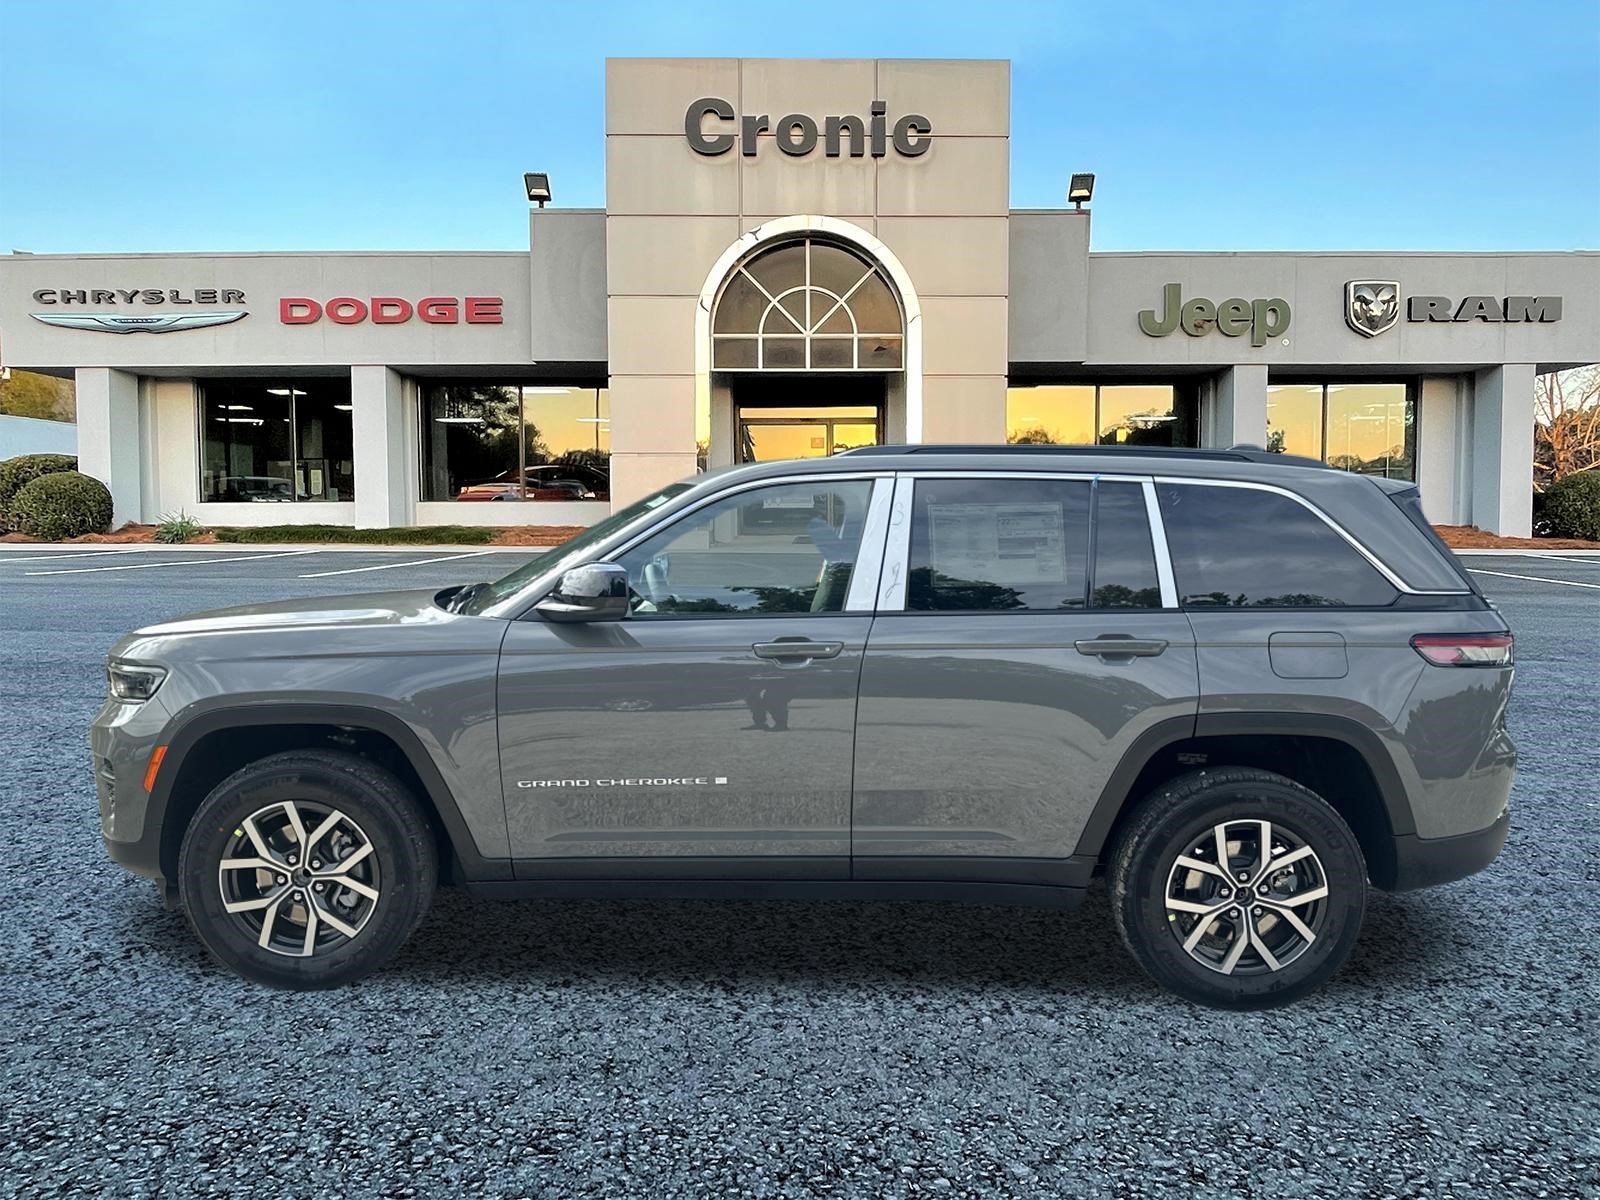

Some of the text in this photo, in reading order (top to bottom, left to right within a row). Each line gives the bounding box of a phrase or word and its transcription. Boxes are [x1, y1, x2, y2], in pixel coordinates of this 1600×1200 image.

[685, 98, 932, 157] Cronic
[32, 289, 246, 304] CHRYSLER
[1407, 296, 1562, 322] RAM
[280, 297, 503, 324] DODGE
[1138, 283, 1291, 347] Jeep
[517, 777, 708, 788] GRAND CHEROKEE
